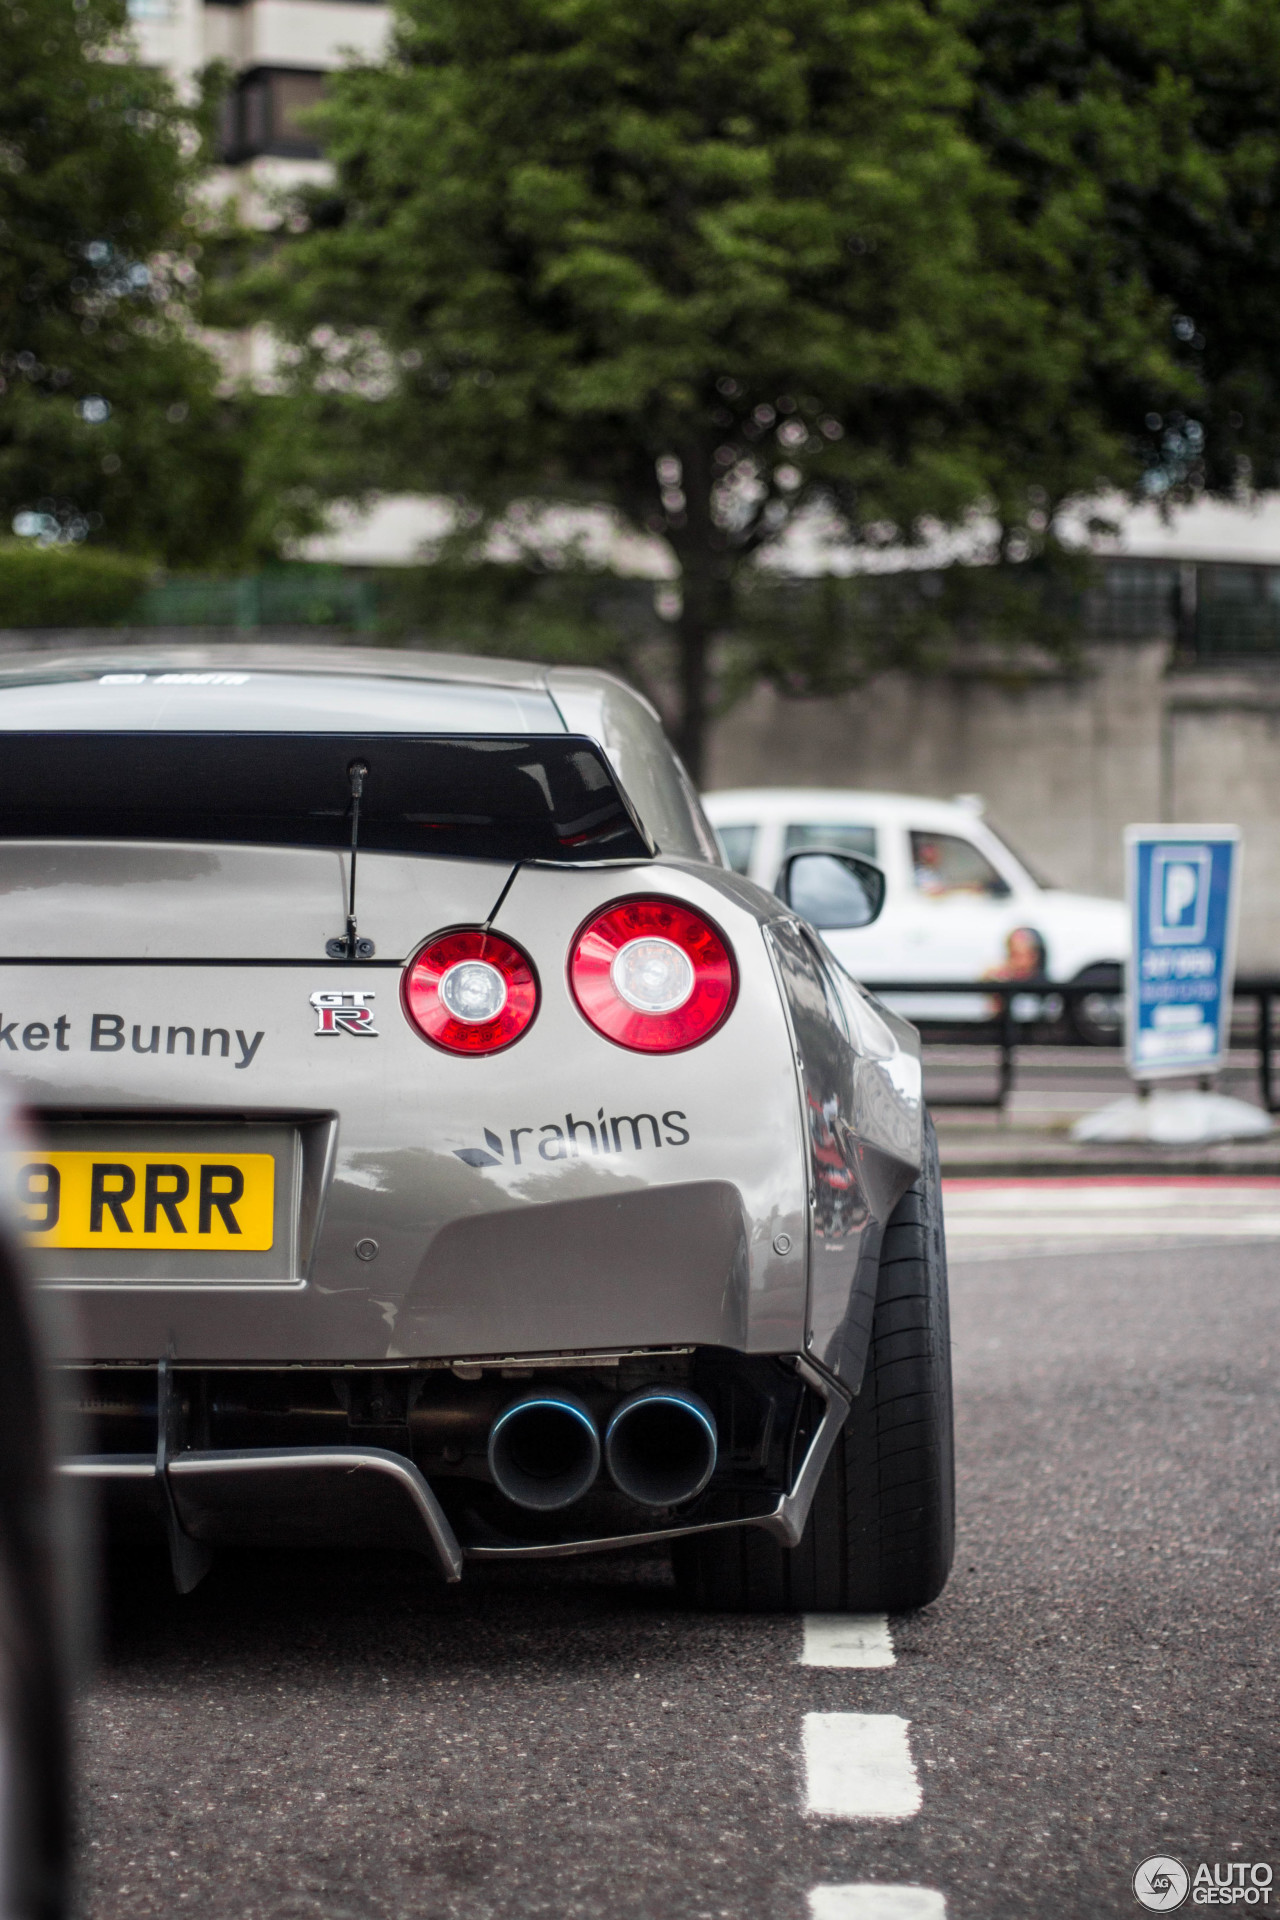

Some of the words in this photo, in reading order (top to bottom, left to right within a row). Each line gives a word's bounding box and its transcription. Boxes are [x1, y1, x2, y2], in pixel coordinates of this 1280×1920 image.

[90, 1013, 265, 1069] Bunny
[509, 1106, 691, 1165] rahims
[89, 1162, 245, 1235] RRR
